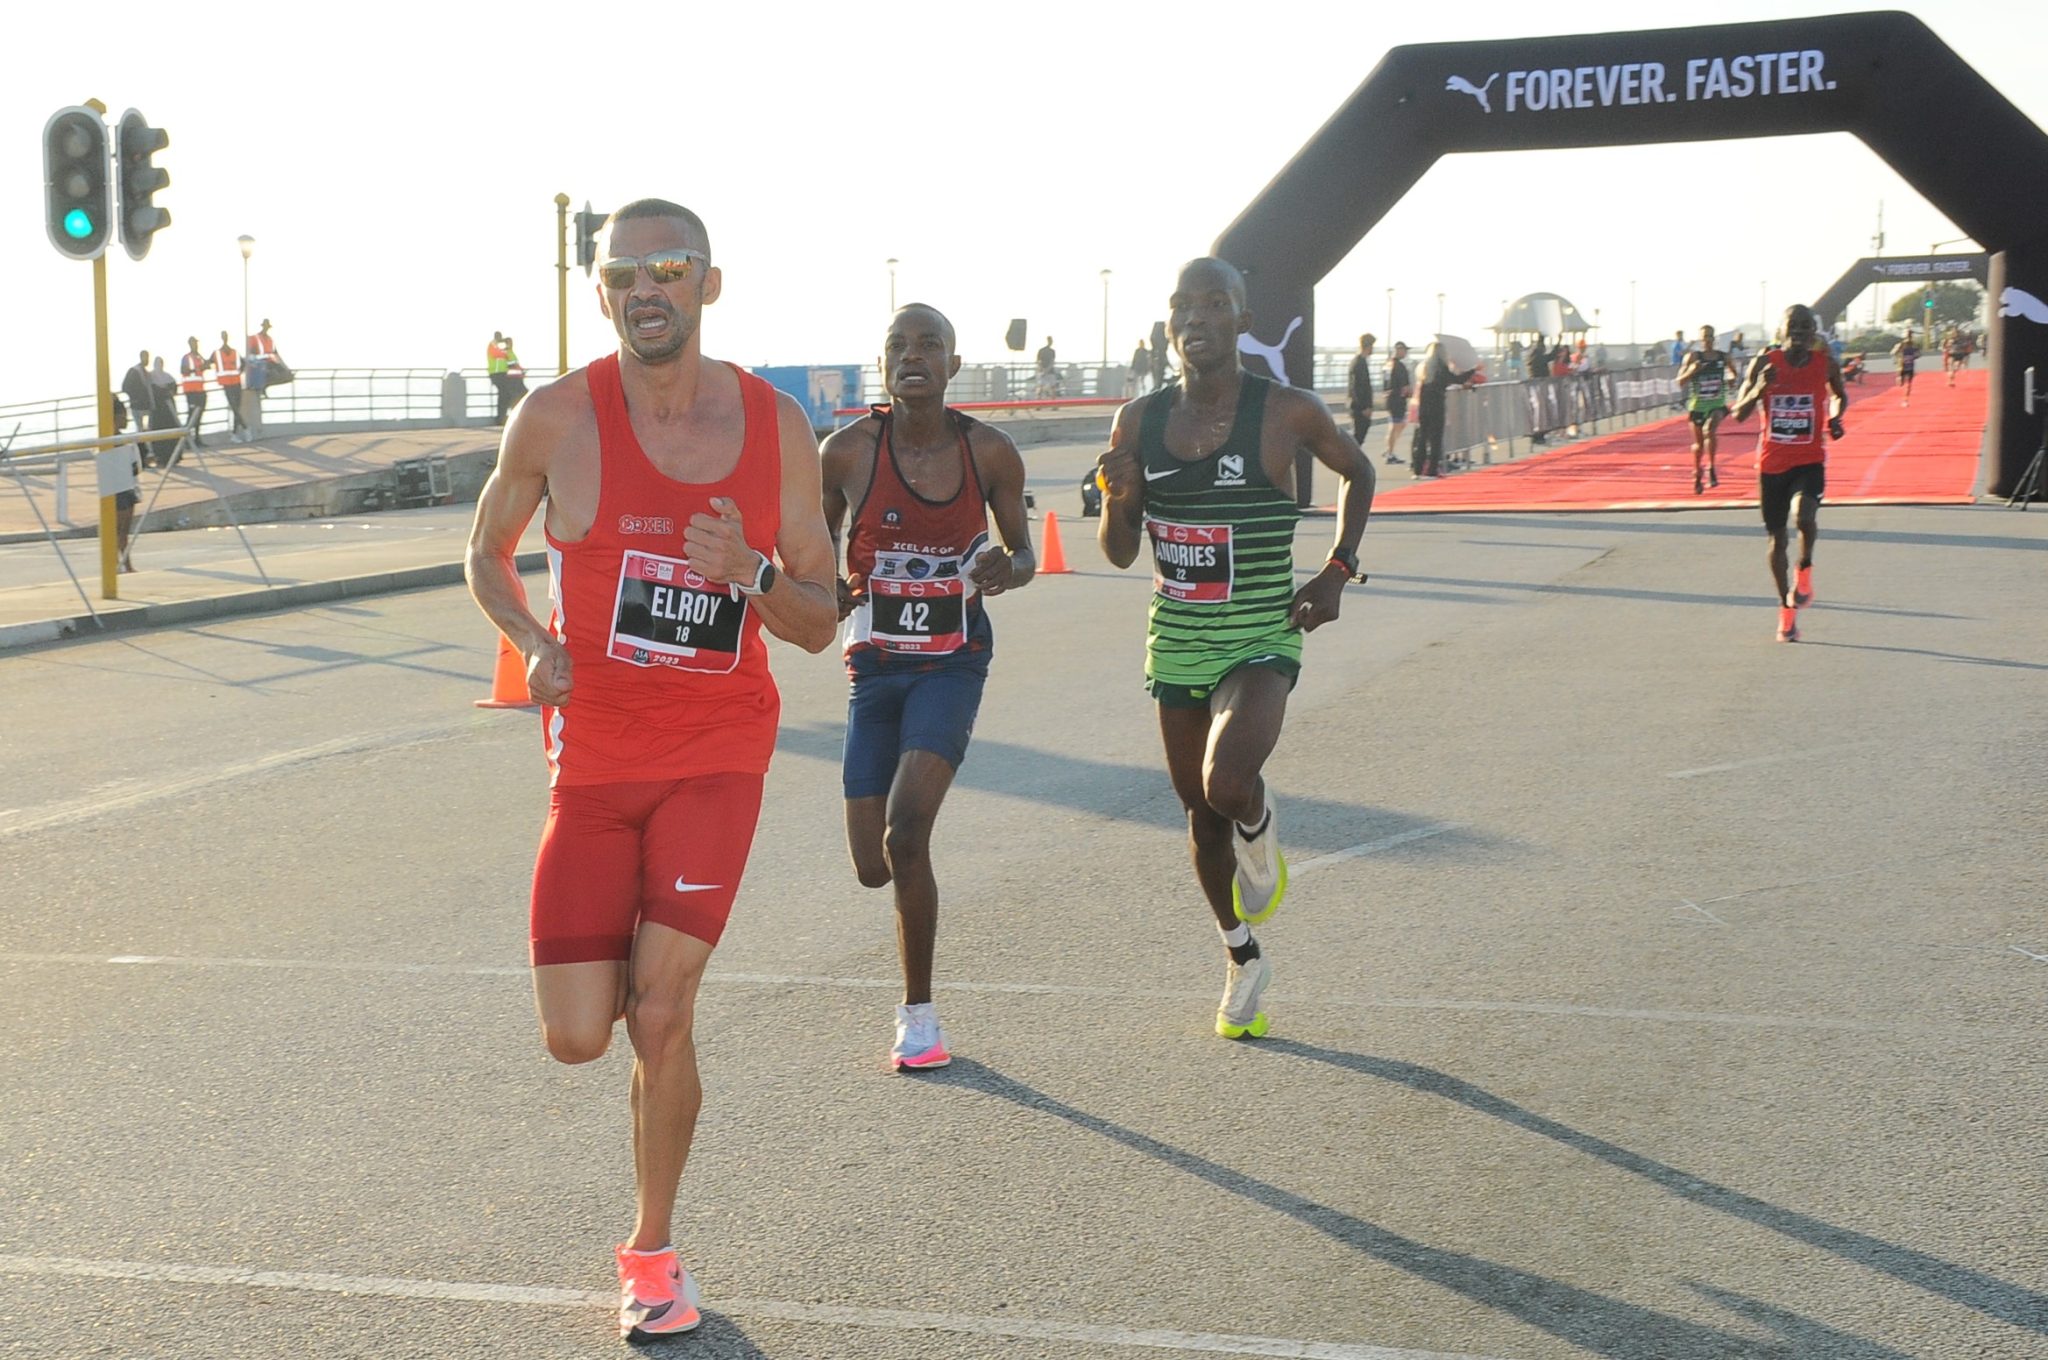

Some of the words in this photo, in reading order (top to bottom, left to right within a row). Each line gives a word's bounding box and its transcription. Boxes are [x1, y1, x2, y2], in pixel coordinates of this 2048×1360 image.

[1505, 61, 1677, 113] FOREVER.
[1686, 49, 1837, 100] FASTER.
[618, 514, 674, 535] BOXER
[891, 541, 919, 553] XCEL
[921, 545, 937, 554] AC
[1156, 539, 1216, 567] ANDRIES
[1176, 567, 1187, 581] 22
[651, 585, 722, 627] ELROY
[898, 602, 930, 632] 42
[675, 625, 691, 643] 18
[652, 654, 680, 665] 2023
